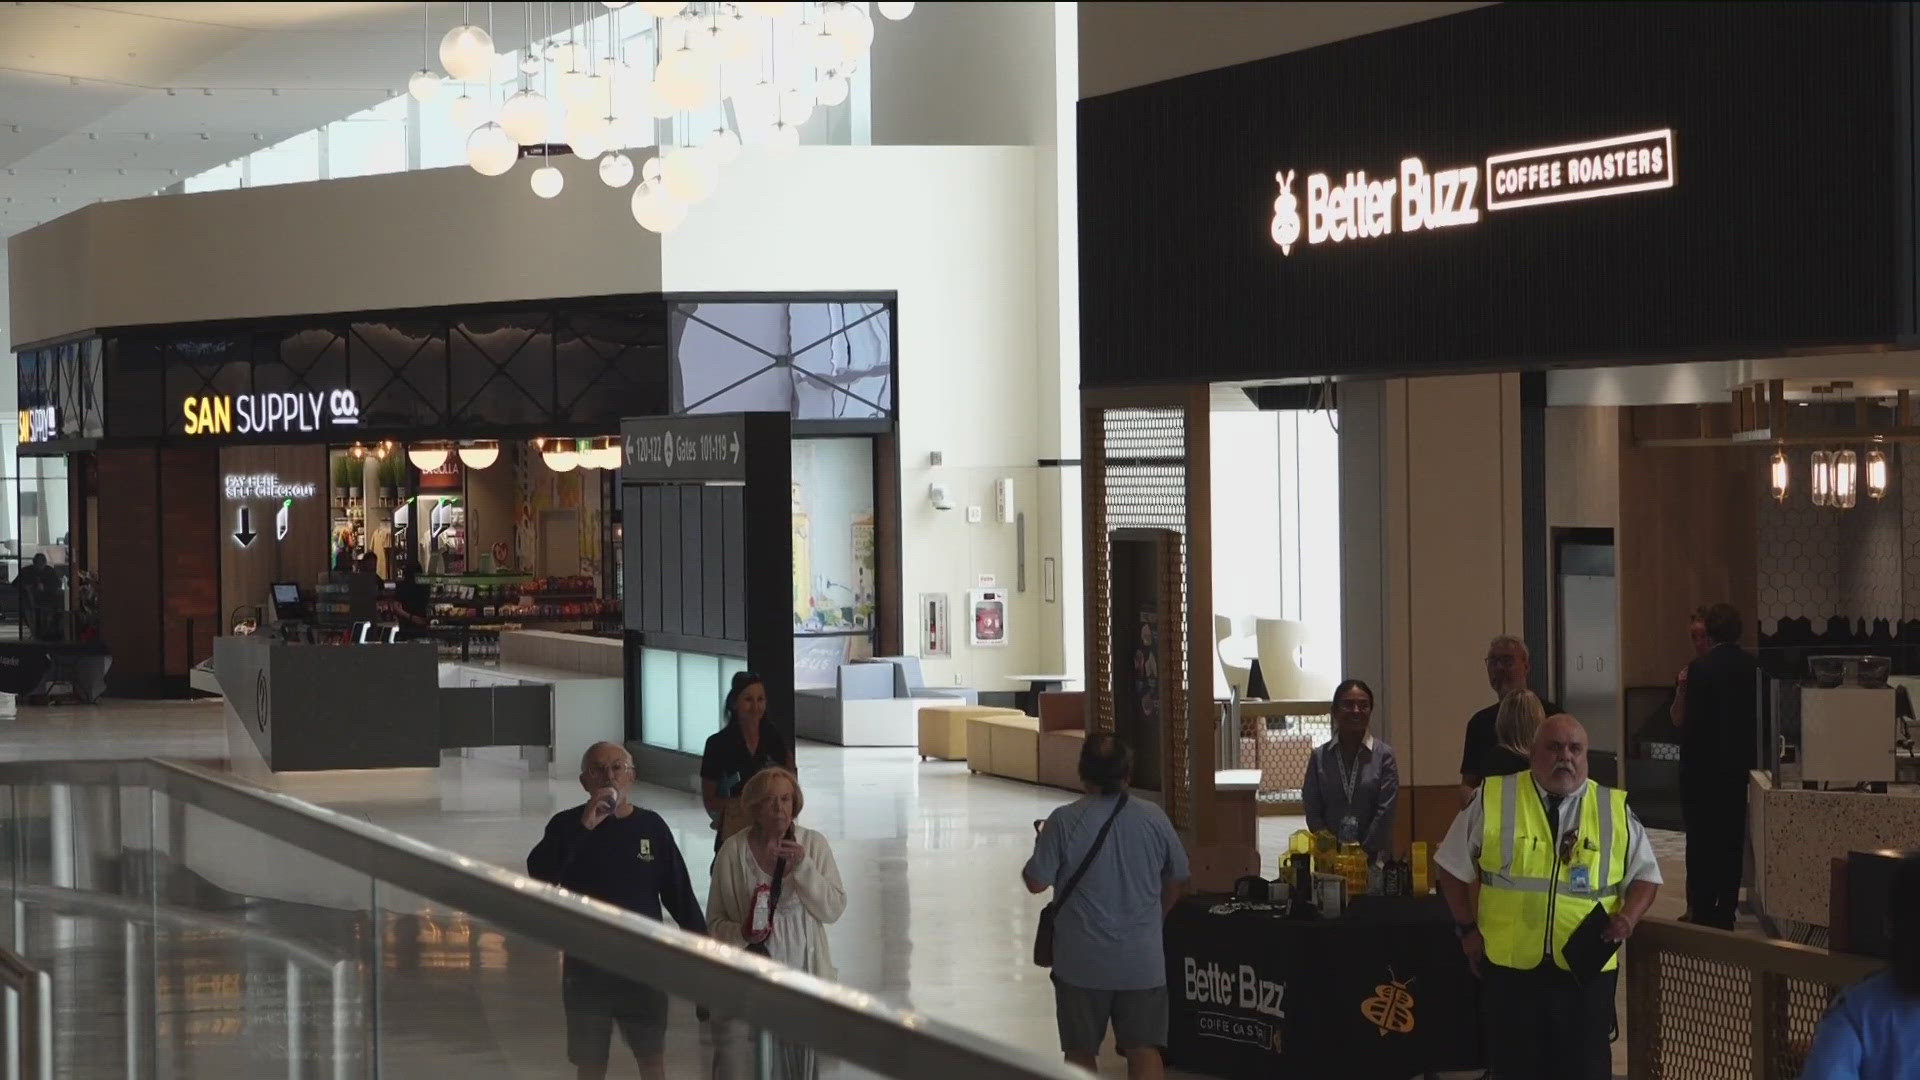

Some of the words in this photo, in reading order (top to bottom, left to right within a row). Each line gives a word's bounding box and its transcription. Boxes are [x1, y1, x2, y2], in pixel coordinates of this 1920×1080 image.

[1308, 172, 1397, 244] Better
[1400, 157, 1479, 232] Buzz
[1495, 161, 1561, 195] COFFEE
[1568, 147, 1663, 184] ROASTERS
[184, 396, 231, 434] SAN
[236, 391, 324, 433] SUPPLY
[637, 436, 661, 462] 120-122
[676, 436, 697, 461] Gates
[700, 435, 727, 461] 101-119
[255, 484, 317, 498] CHECKOUT
